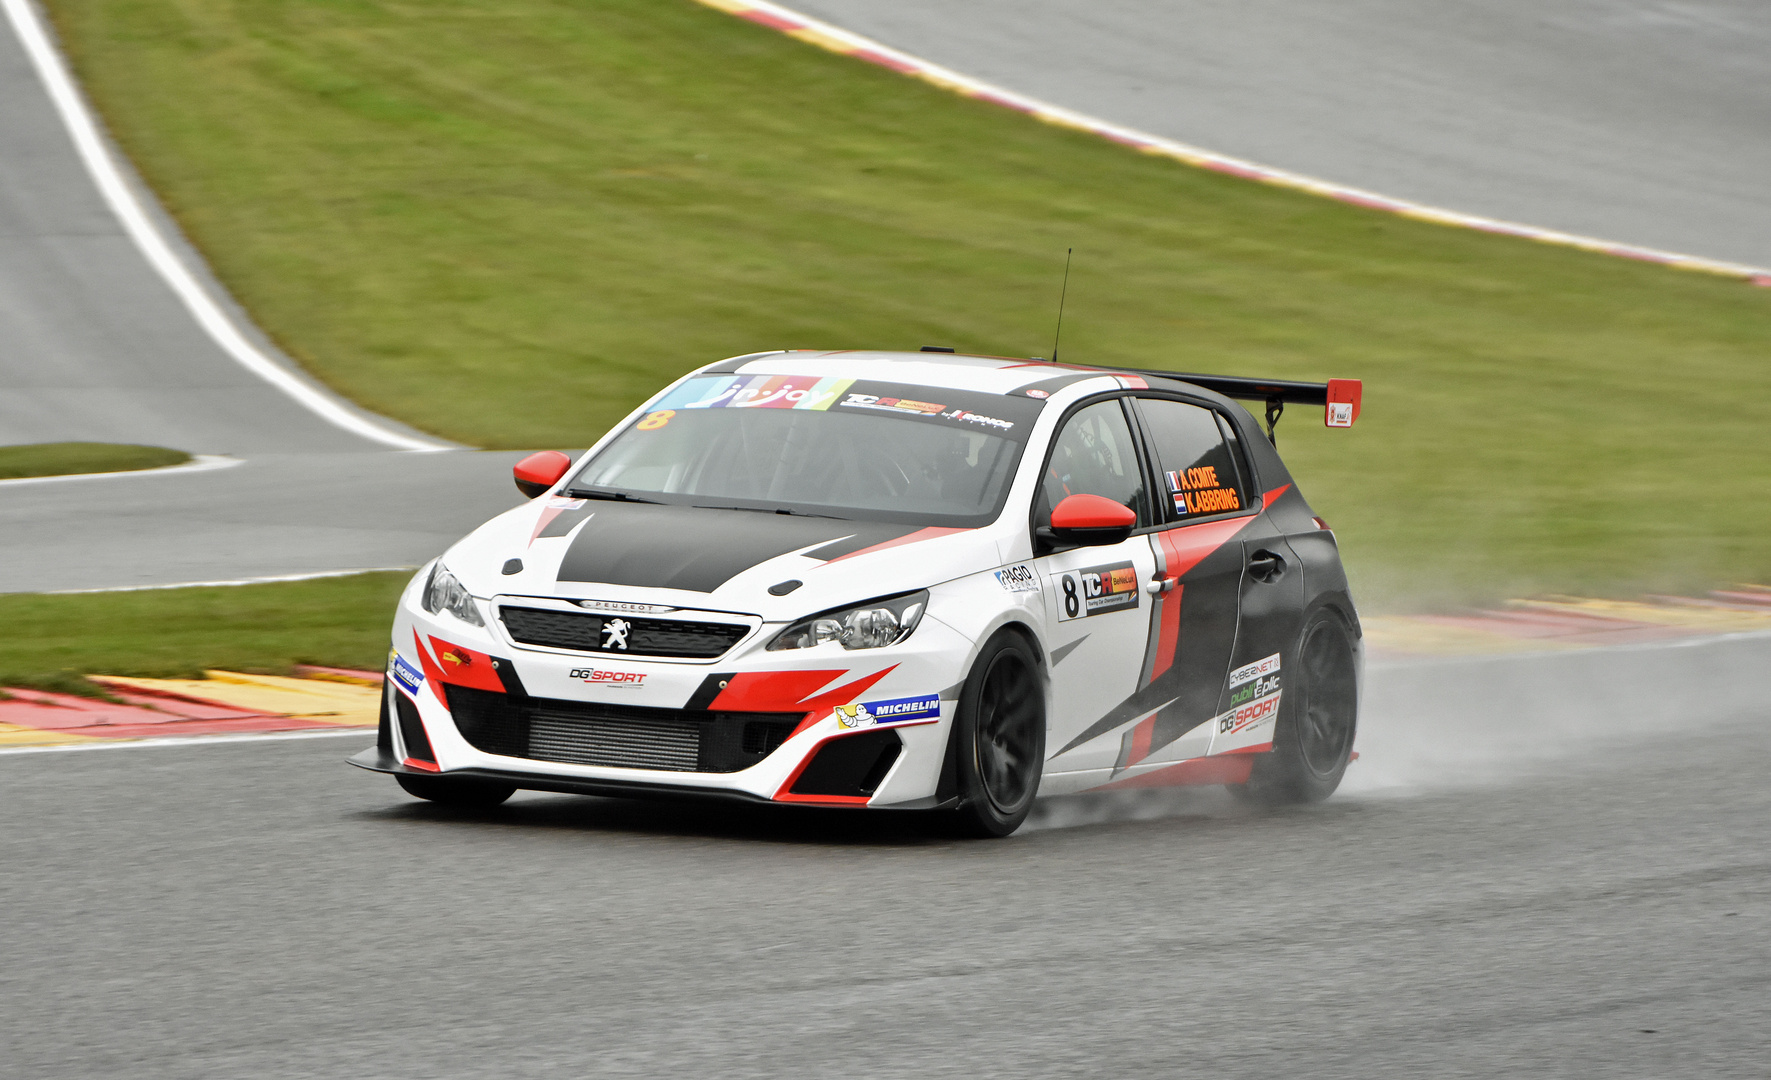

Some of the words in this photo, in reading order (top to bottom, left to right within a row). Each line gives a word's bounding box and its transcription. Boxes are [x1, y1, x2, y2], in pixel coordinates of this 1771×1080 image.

[636, 410, 677, 431] 8
[950, 410, 1014, 428] KRONOS
[1061, 574, 1080, 618] 8
[1081, 571, 1113, 598] TCR
[595, 602, 653, 611] PEUGEOT
[395, 662, 423, 688] MICHELIN
[1230, 659, 1273, 685] CYBERNET
[876, 699, 939, 715] MICHELIN
